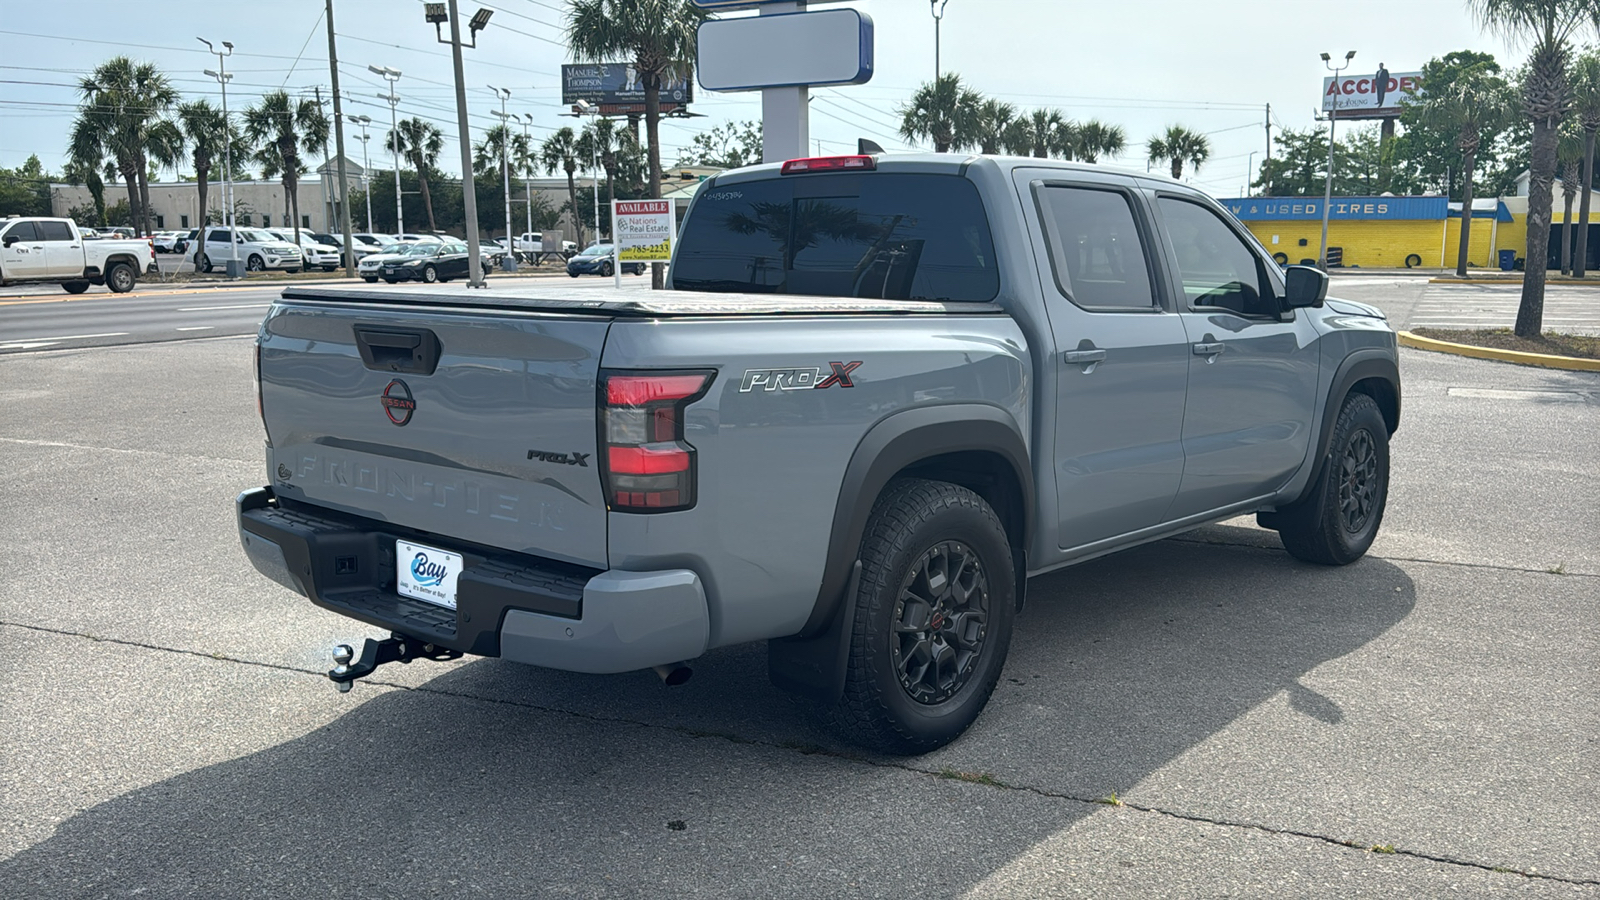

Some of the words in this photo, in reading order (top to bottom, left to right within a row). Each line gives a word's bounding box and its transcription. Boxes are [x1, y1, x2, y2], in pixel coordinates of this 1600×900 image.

[567, 67, 595, 77] MANUEL
[567, 77, 602, 87] THOMPSON
[619, 203, 667, 212] AVAILABLE
[1250, 205, 1258, 214] &
[1265, 203, 1317, 215] USED
[629, 225, 645, 233] Real
[646, 224, 669, 233] Estate
[632, 244, 669, 253] 785-2233
[381, 396, 414, 409] NISSAN
[297, 454, 566, 530] FRONTIER
[414, 552, 447, 586] Bay
